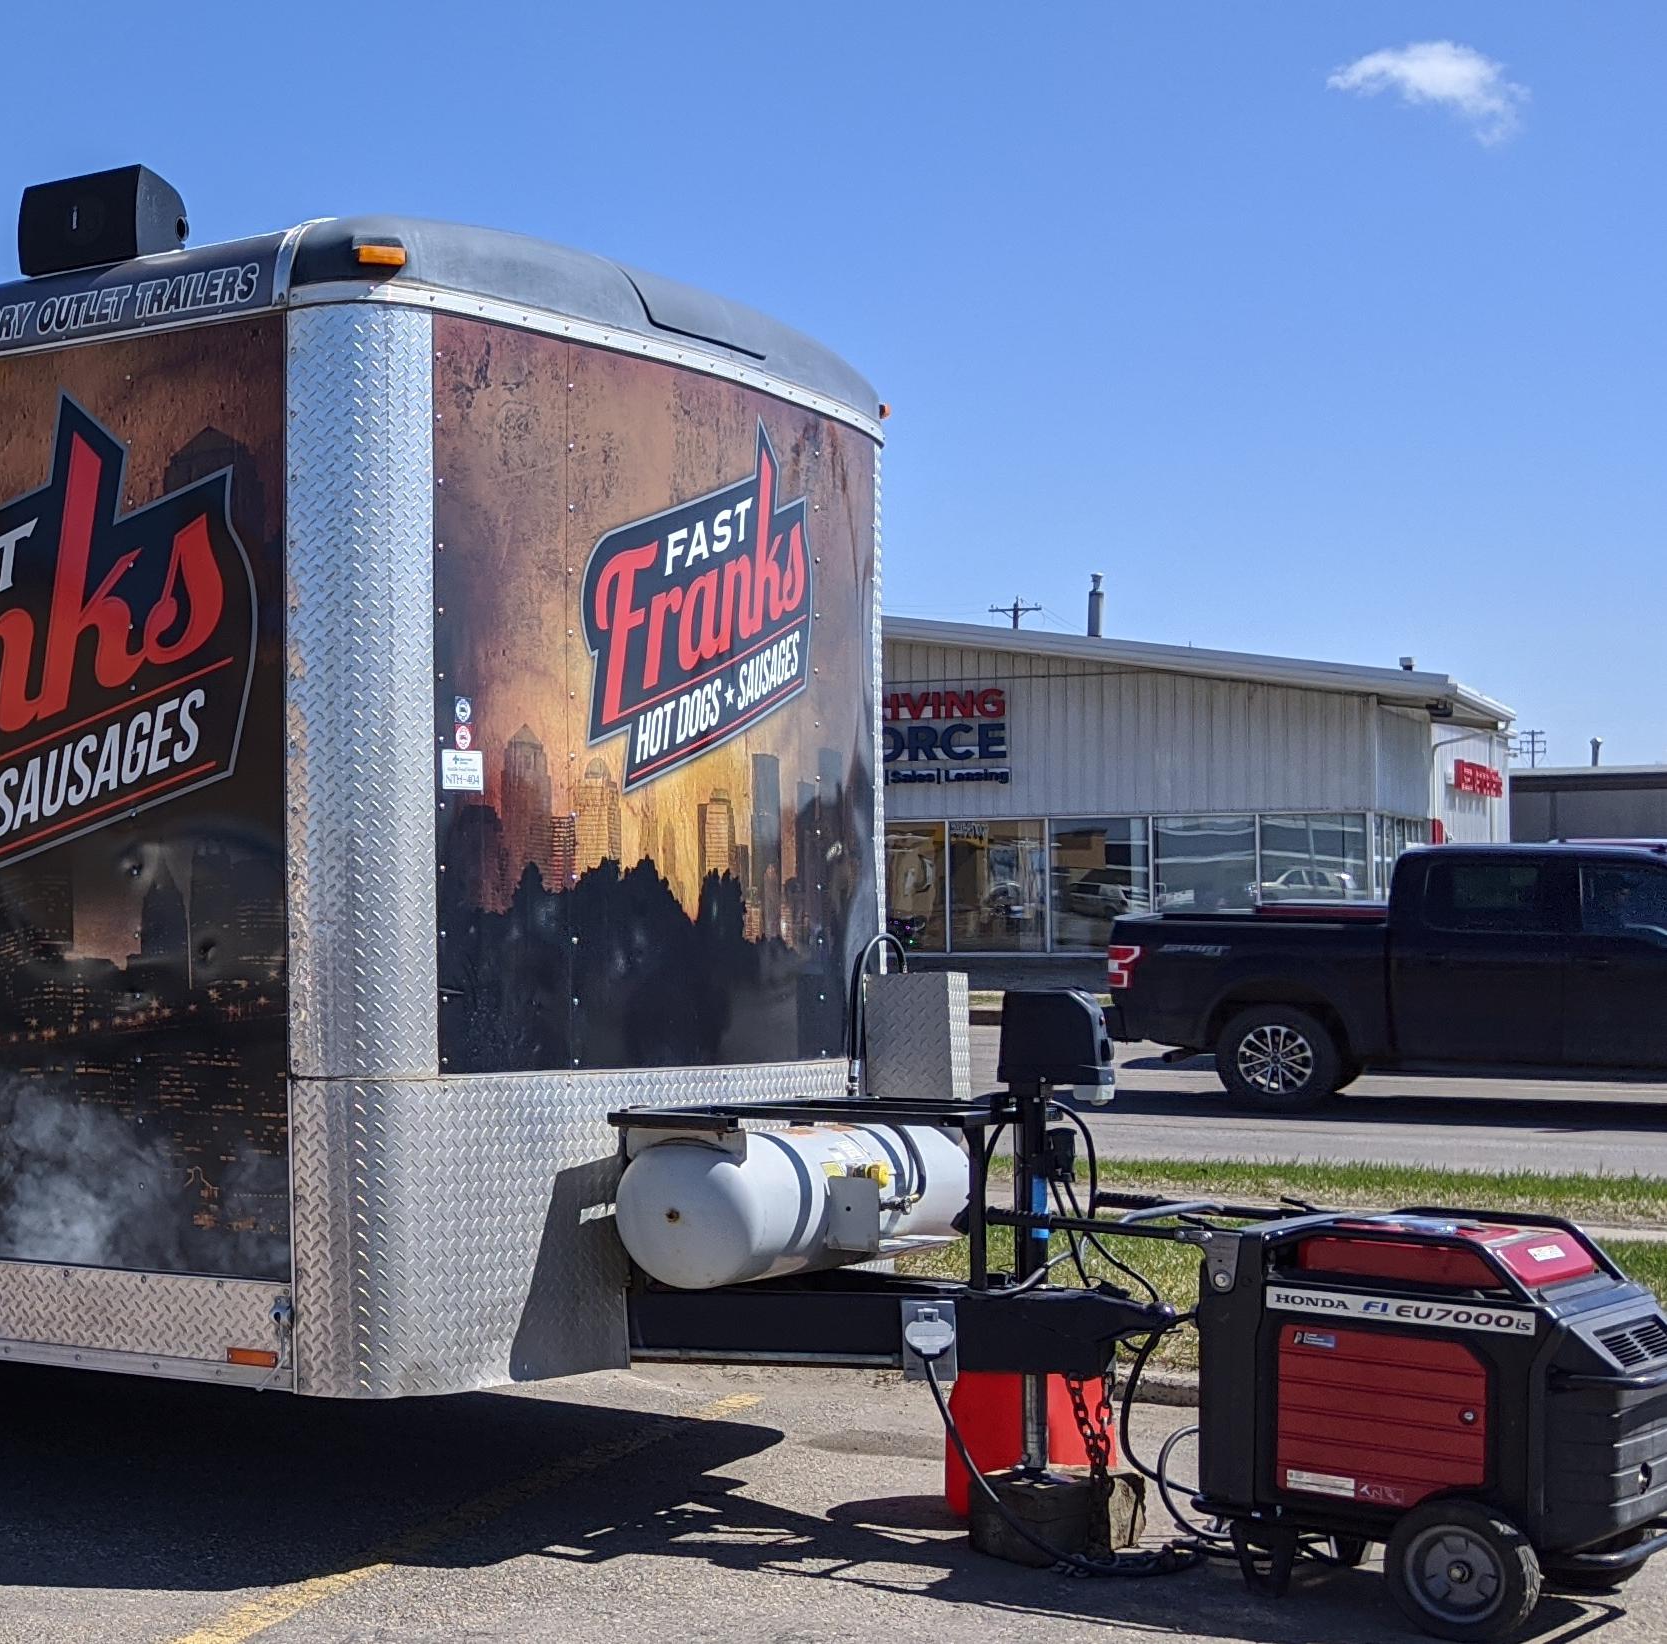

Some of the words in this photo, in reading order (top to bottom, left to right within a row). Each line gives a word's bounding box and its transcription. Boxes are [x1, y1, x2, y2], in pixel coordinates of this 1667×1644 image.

[37, 283, 133, 335] OUTLET
[135, 262, 260, 319] TRAILERS
[664, 497, 754, 577] FAST
[595, 447, 806, 726] Franks
[635, 699, 678, 764] HOT
[675, 677, 723, 738] DOGS
[737, 630, 801, 711] SAUSAGES
[883, 688, 1006, 721] IVING
[883, 723, 1007, 763] ORCE
[944, 768, 1010, 784] Leasing
[1274, 1293, 1350, 1311] HONDA
